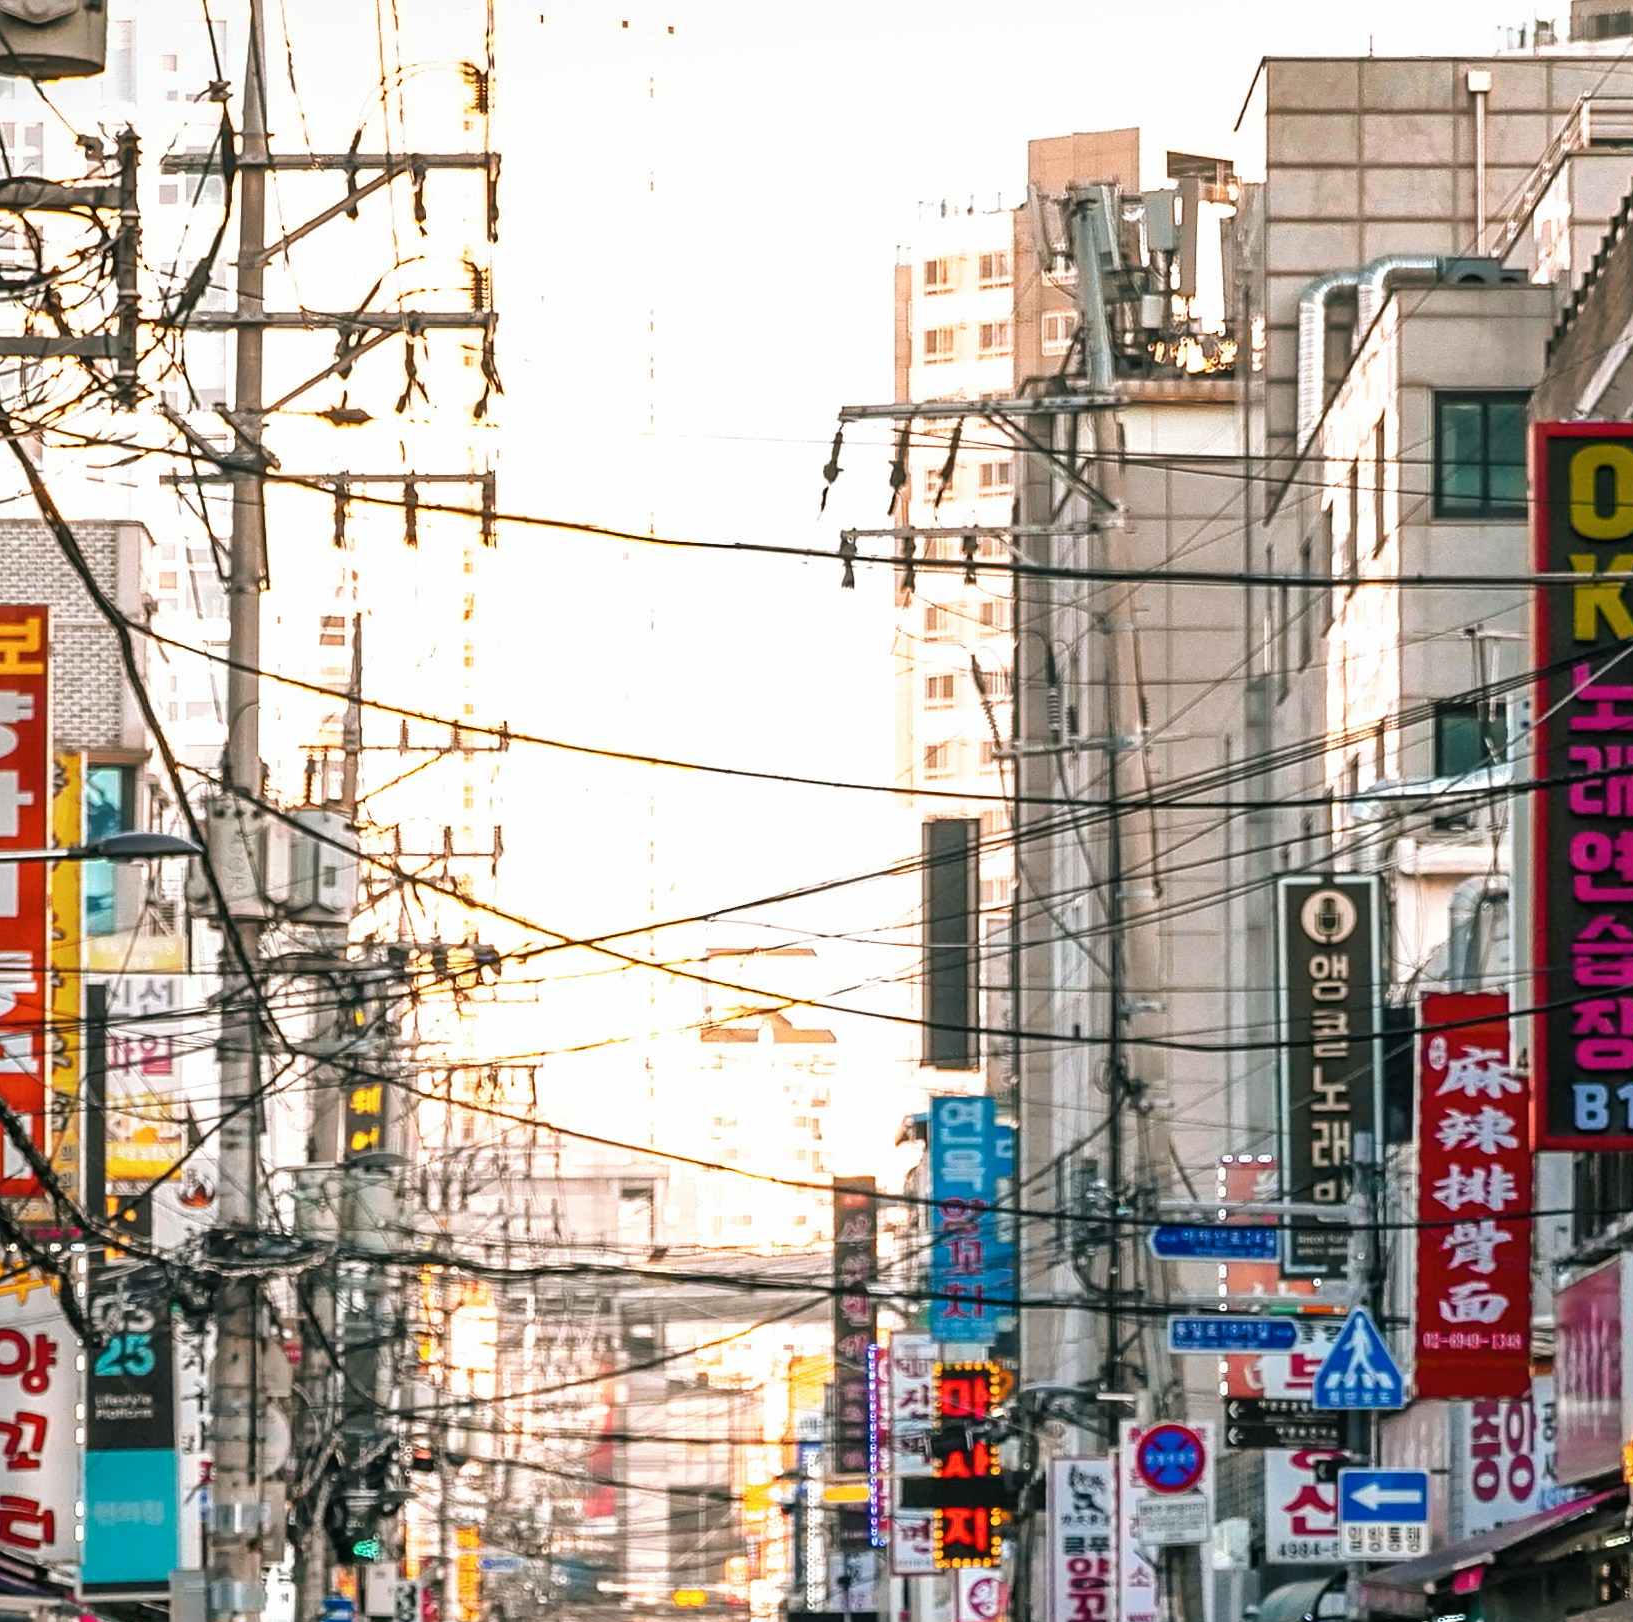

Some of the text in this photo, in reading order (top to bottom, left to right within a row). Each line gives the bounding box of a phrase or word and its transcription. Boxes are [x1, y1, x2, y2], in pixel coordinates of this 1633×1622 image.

[94, 1335, 156, 1377] 25
[940, 1376, 991, 1552] 마사지
[1348, 1526, 1421, 1553] 일방통행
